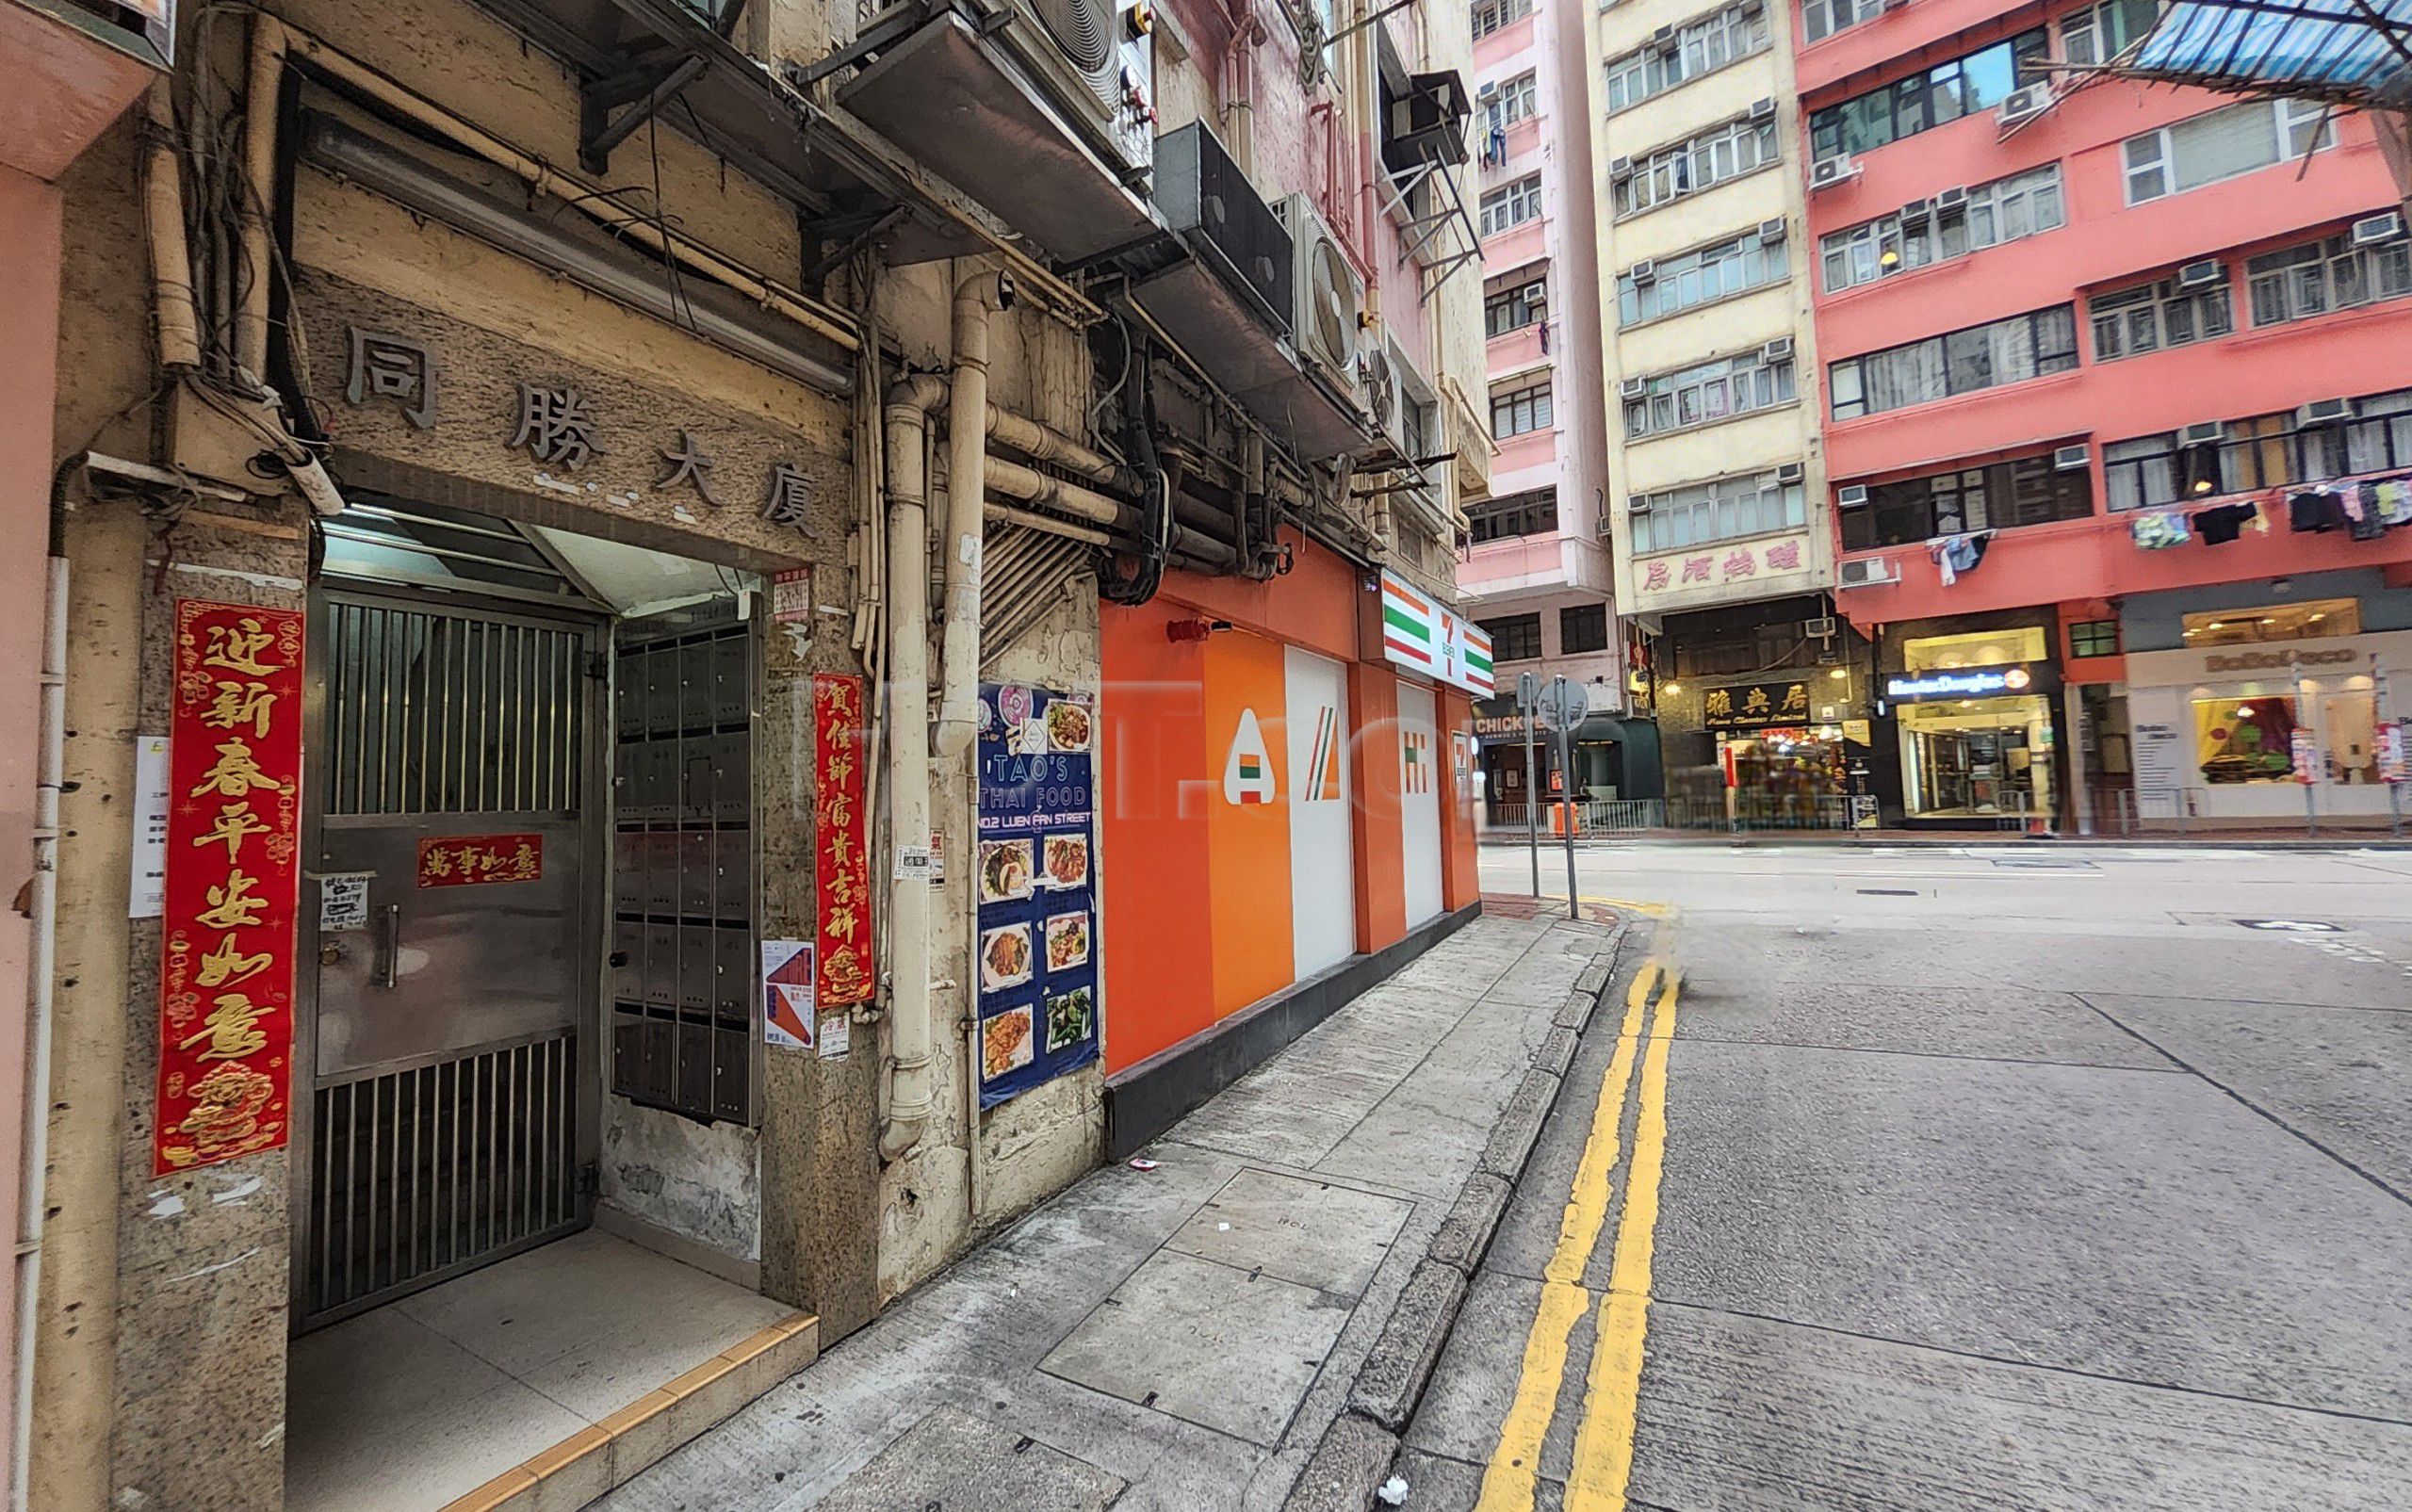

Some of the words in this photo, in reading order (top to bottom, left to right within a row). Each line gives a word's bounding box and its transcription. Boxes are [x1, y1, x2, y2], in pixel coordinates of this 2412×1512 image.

[345, 324, 820, 540] 同勝大廈
[1706, 684, 1808, 717] 雅典居
[993, 754, 1068, 782] TAO'S
[824, 681, 859, 944] 賀佳節富貴吉祥
[980, 787, 1026, 809] THAI
[1035, 786, 1085, 806] FOOD
[1054, 811, 1091, 824] STREET
[177, 618, 286, 1064] 迎新春平安如意
[424, 843, 541, 877] 萬事如意
